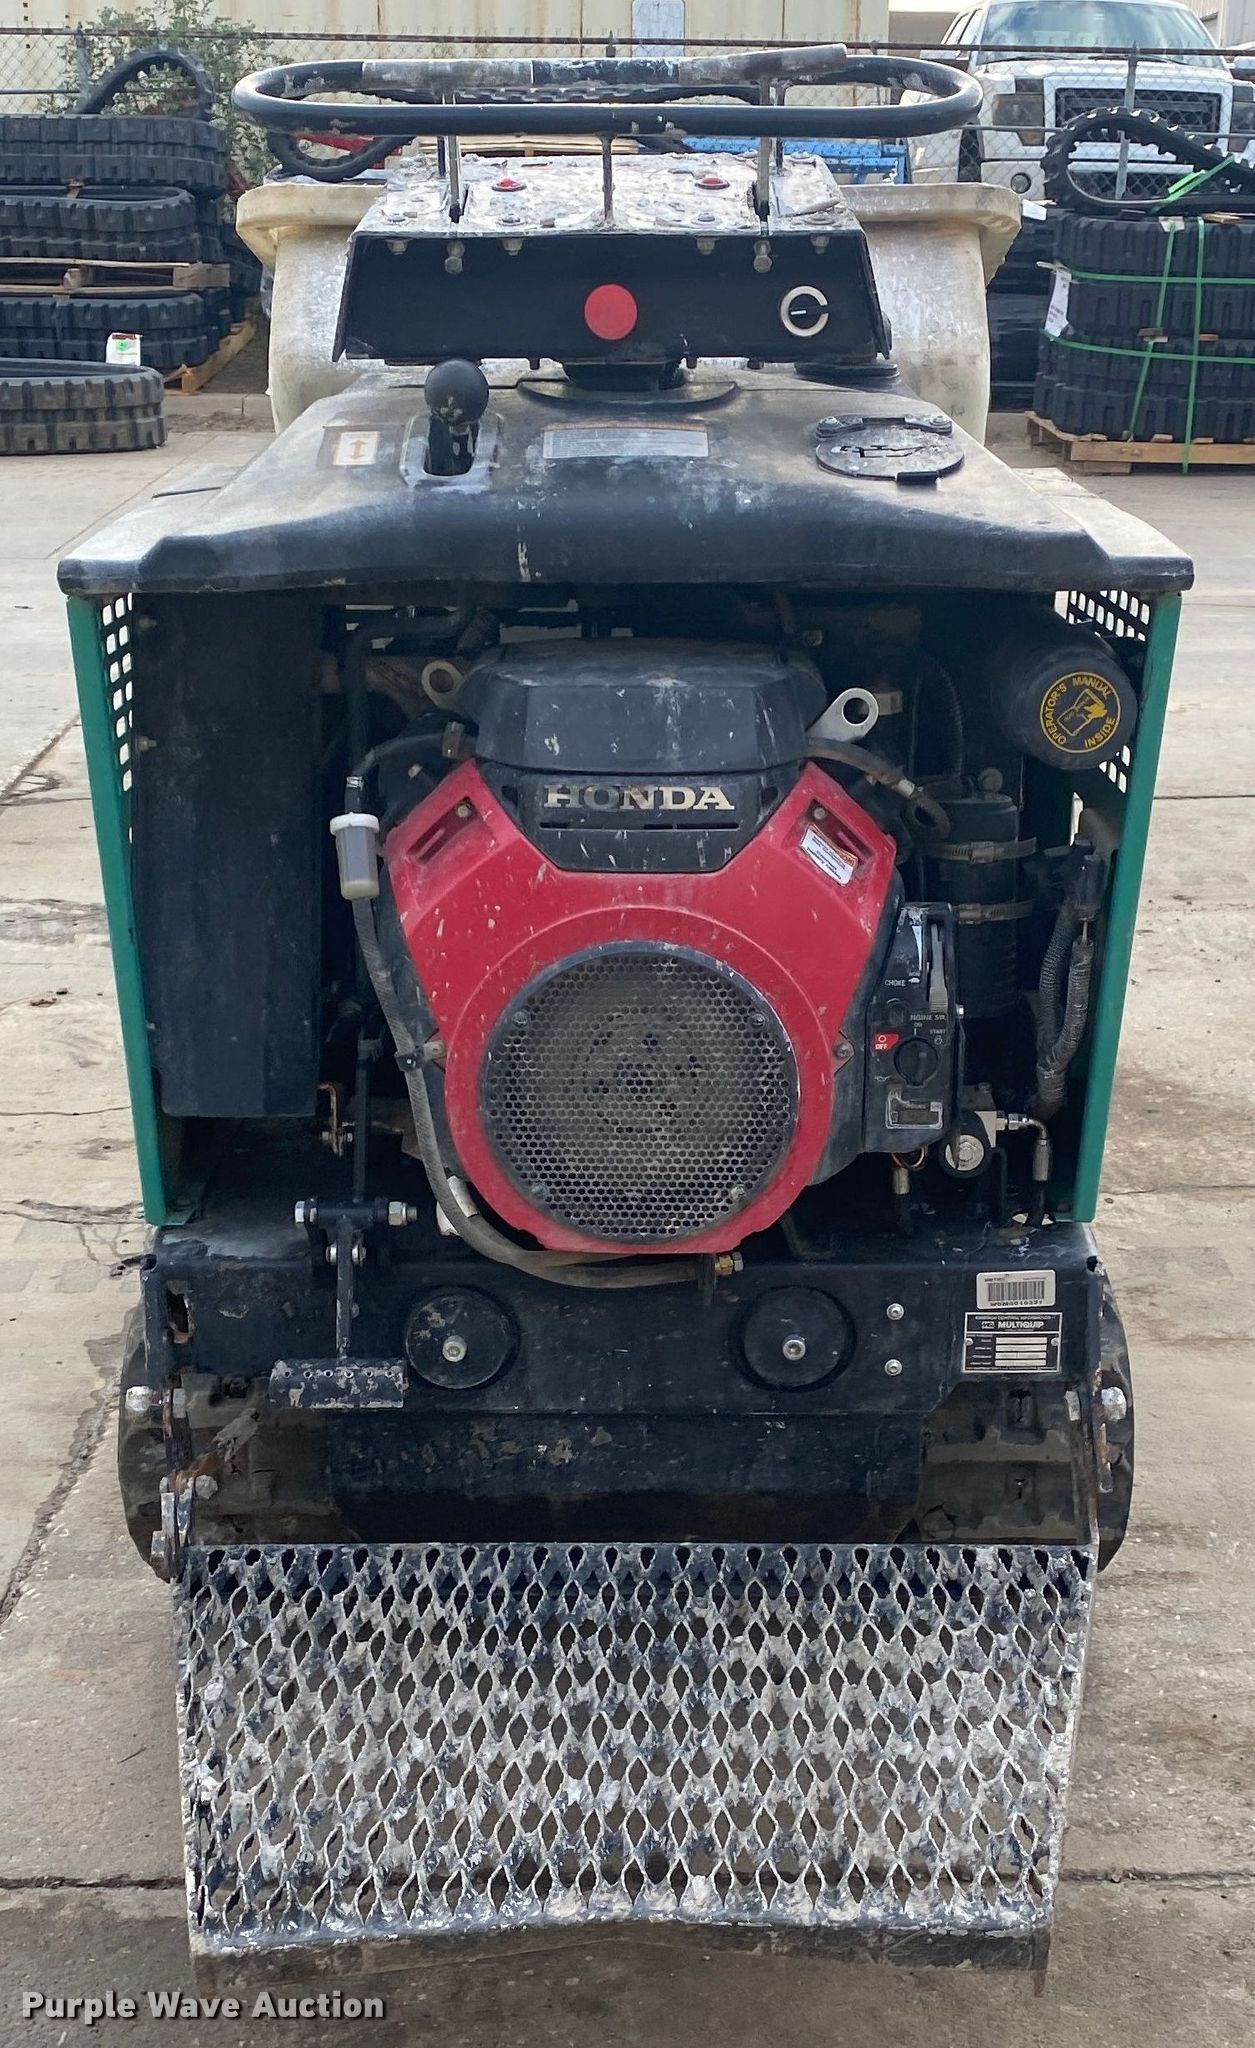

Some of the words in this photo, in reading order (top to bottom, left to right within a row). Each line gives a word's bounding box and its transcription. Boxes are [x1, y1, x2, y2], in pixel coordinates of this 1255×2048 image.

[1045, 683, 1067, 745] OPERATOR'S
[1072, 676, 1111, 700] MANUAL
[1084, 716, 1116, 748] INSIDE
[543, 784, 736, 811] HONDA
[884, 979, 906, 987] CHOKE
[997, 1321, 1045, 1329] MULTIQUIP
